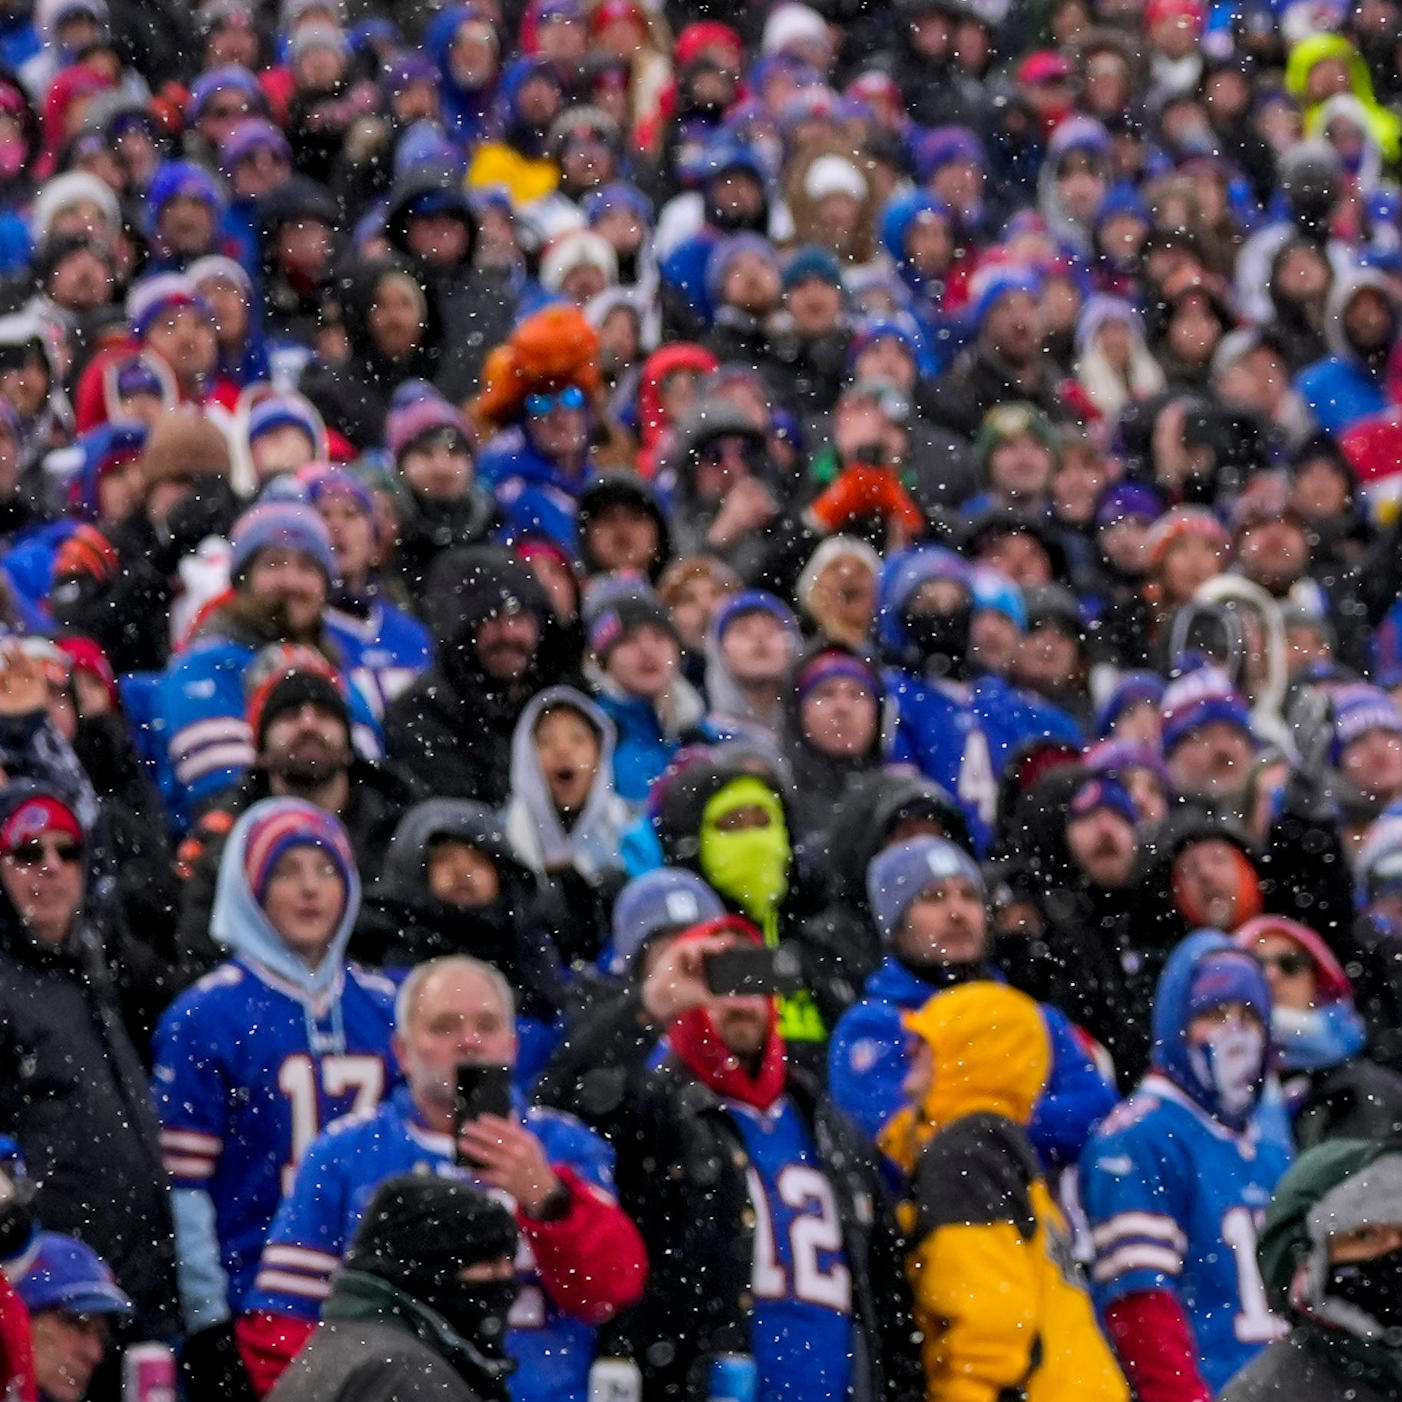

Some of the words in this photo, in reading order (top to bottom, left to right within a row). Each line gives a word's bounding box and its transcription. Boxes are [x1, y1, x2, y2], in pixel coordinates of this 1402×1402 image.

[278, 1053, 386, 1199] 17
[745, 1164, 853, 1316] 12
[1222, 1206, 1293, 1343] 1
